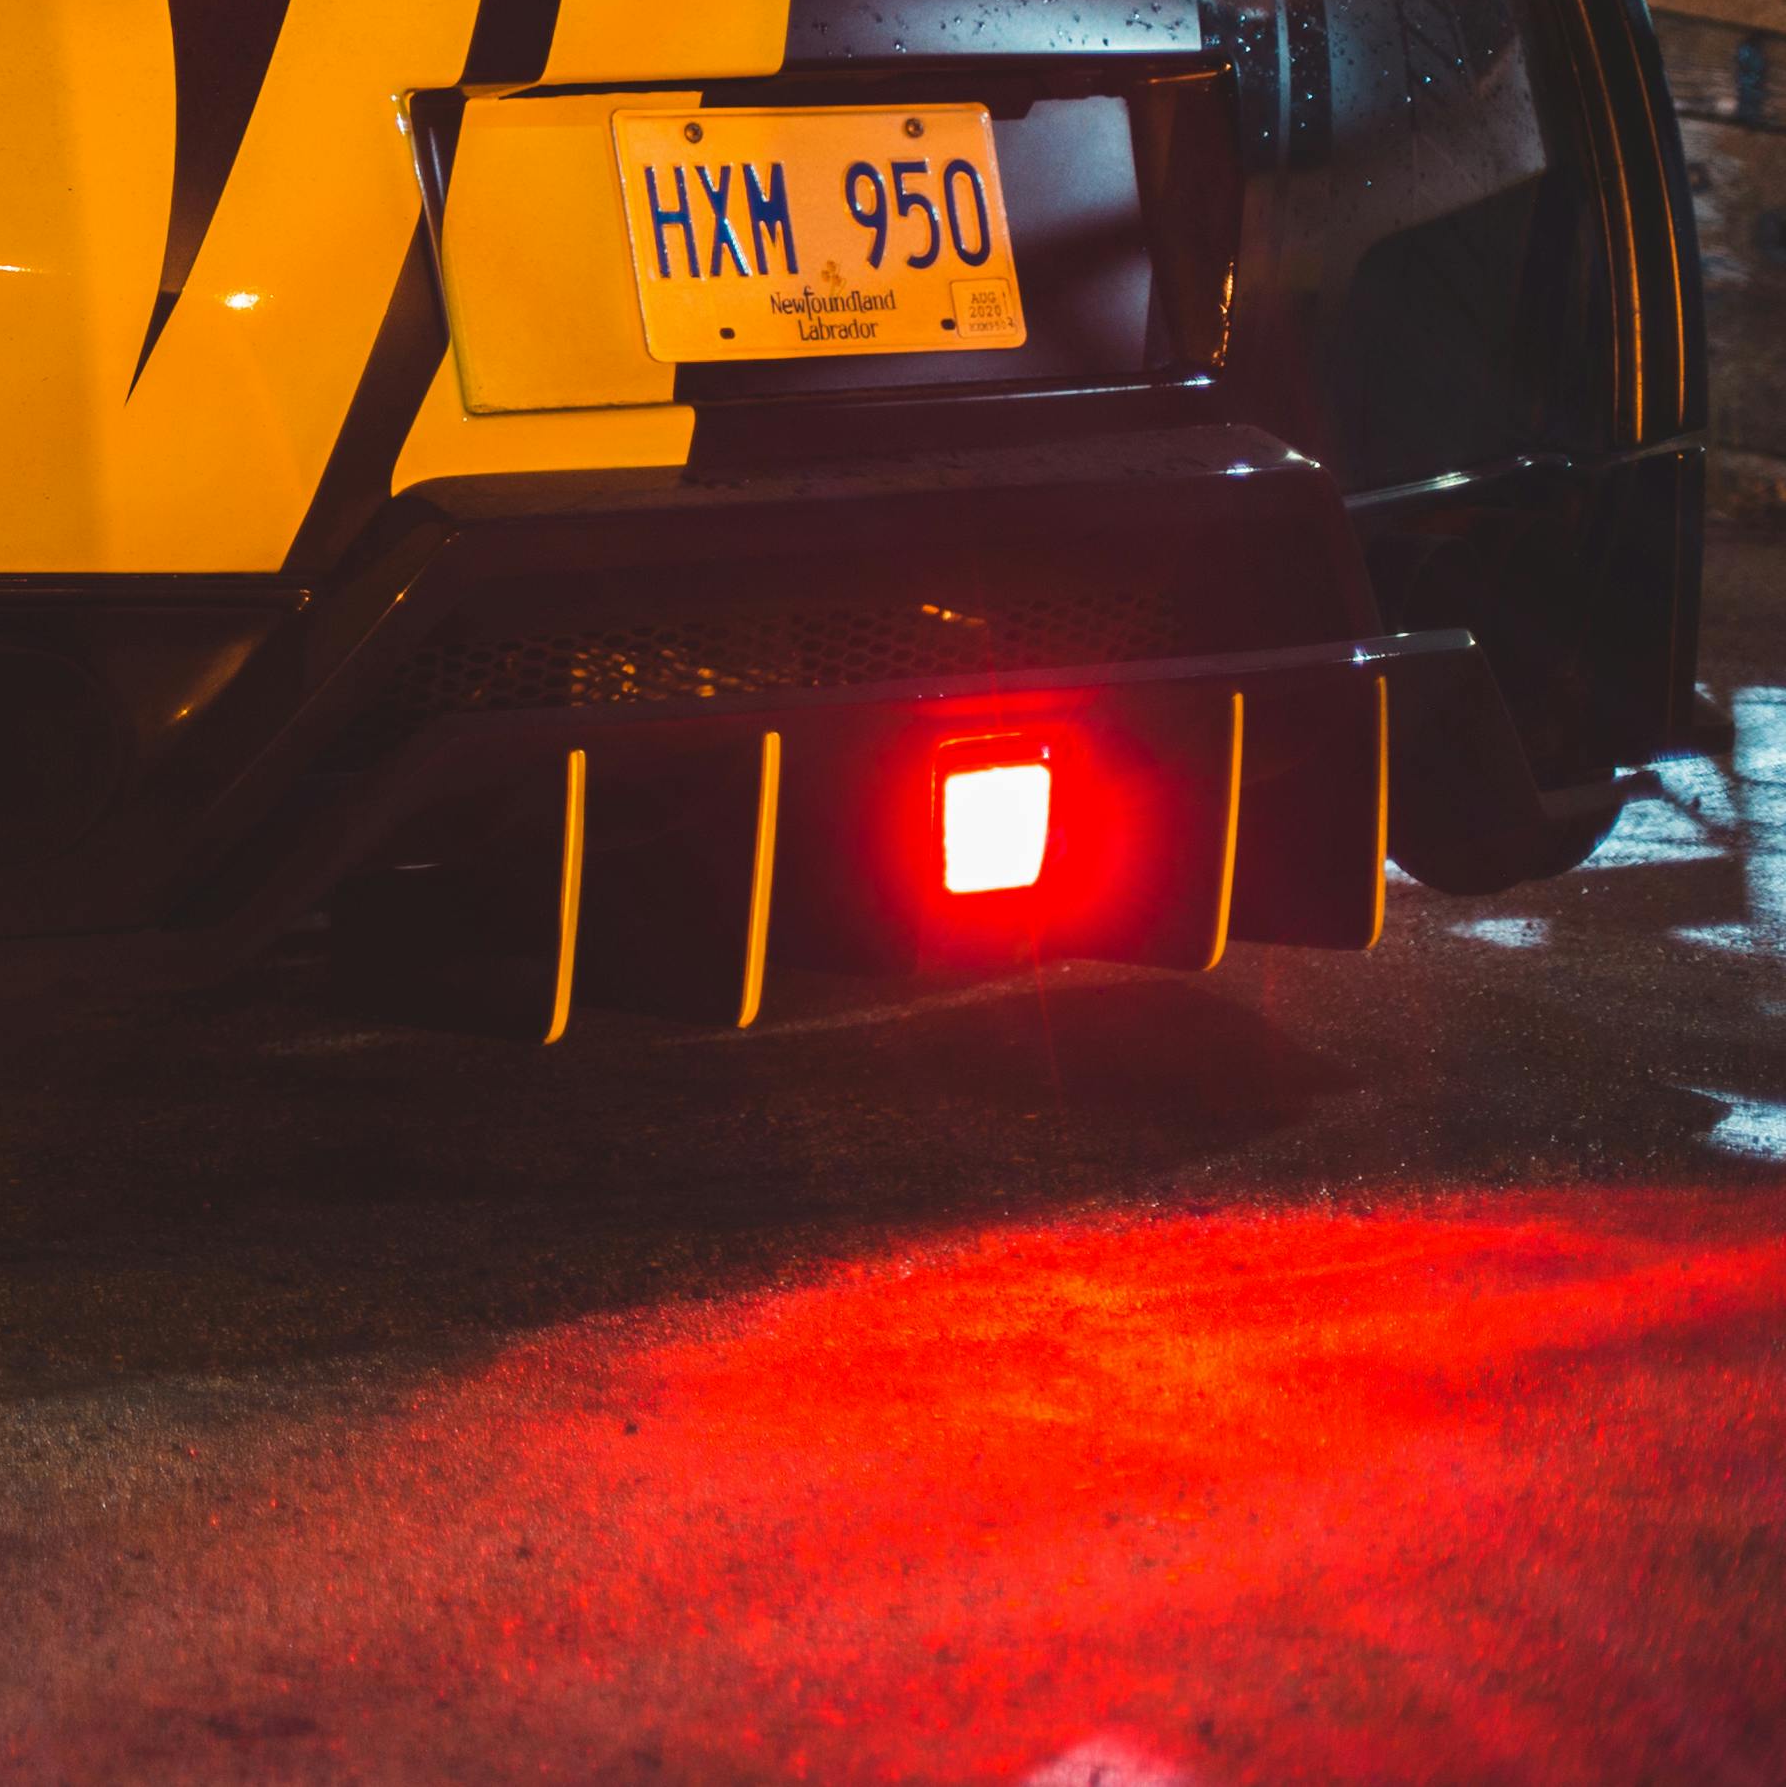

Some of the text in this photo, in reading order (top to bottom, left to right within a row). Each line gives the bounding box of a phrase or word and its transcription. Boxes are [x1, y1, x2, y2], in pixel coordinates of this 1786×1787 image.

[642, 158, 992, 279] HXM 950
[769, 285, 897, 320] Newfoundland
[970, 291, 997, 305] AUG
[969, 304, 1003, 319] 2020
[797, 316, 879, 342] Labrador
